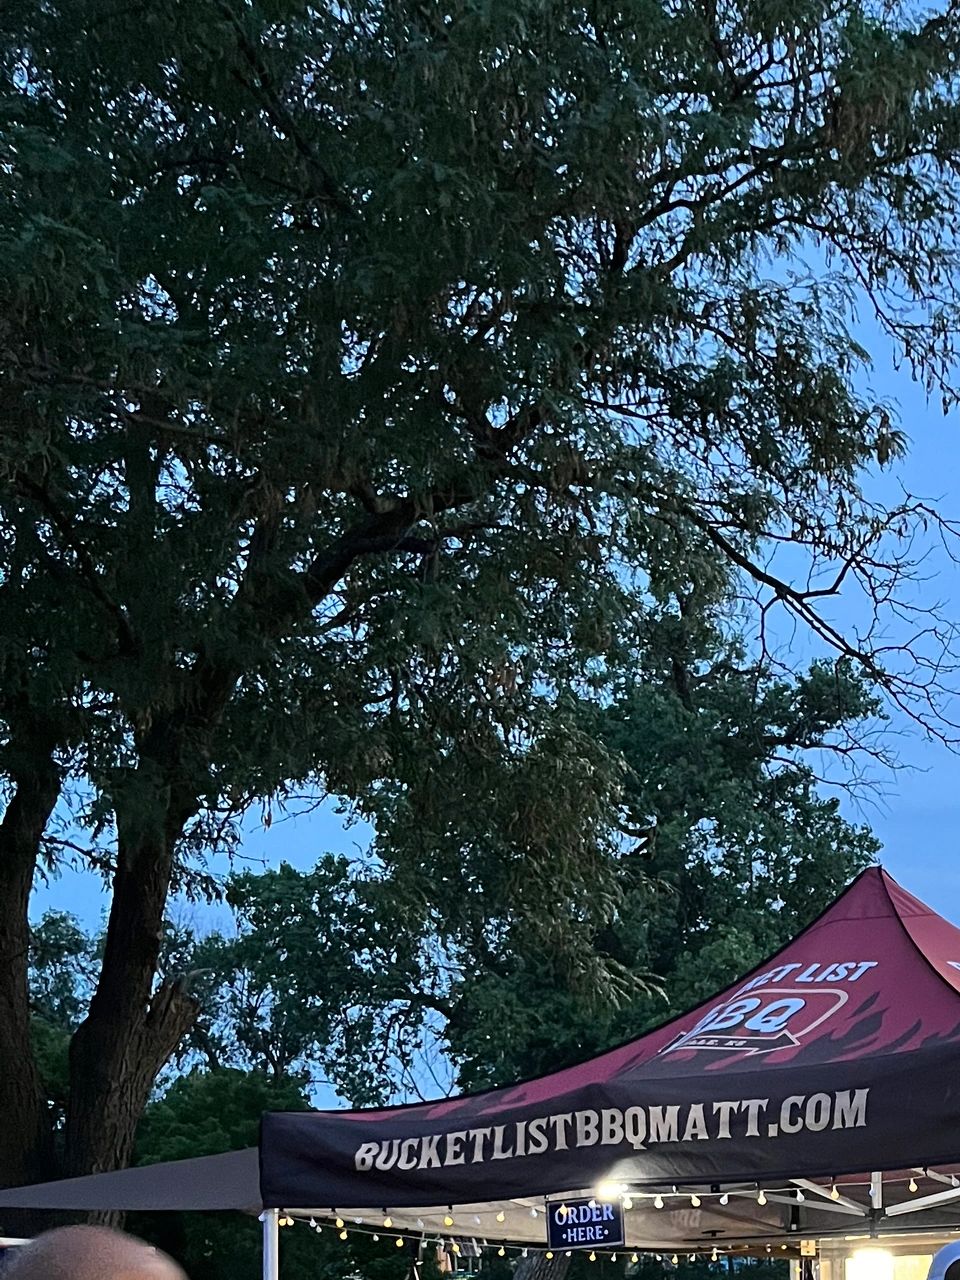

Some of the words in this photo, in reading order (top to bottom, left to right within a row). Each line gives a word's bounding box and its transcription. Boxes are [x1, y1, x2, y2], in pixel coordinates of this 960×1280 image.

[795, 961, 878, 983] LIST
[354, 1087, 870, 1172] BUCKETLISTBBQMATT.COM
[554, 1202, 615, 1226] ORDER
